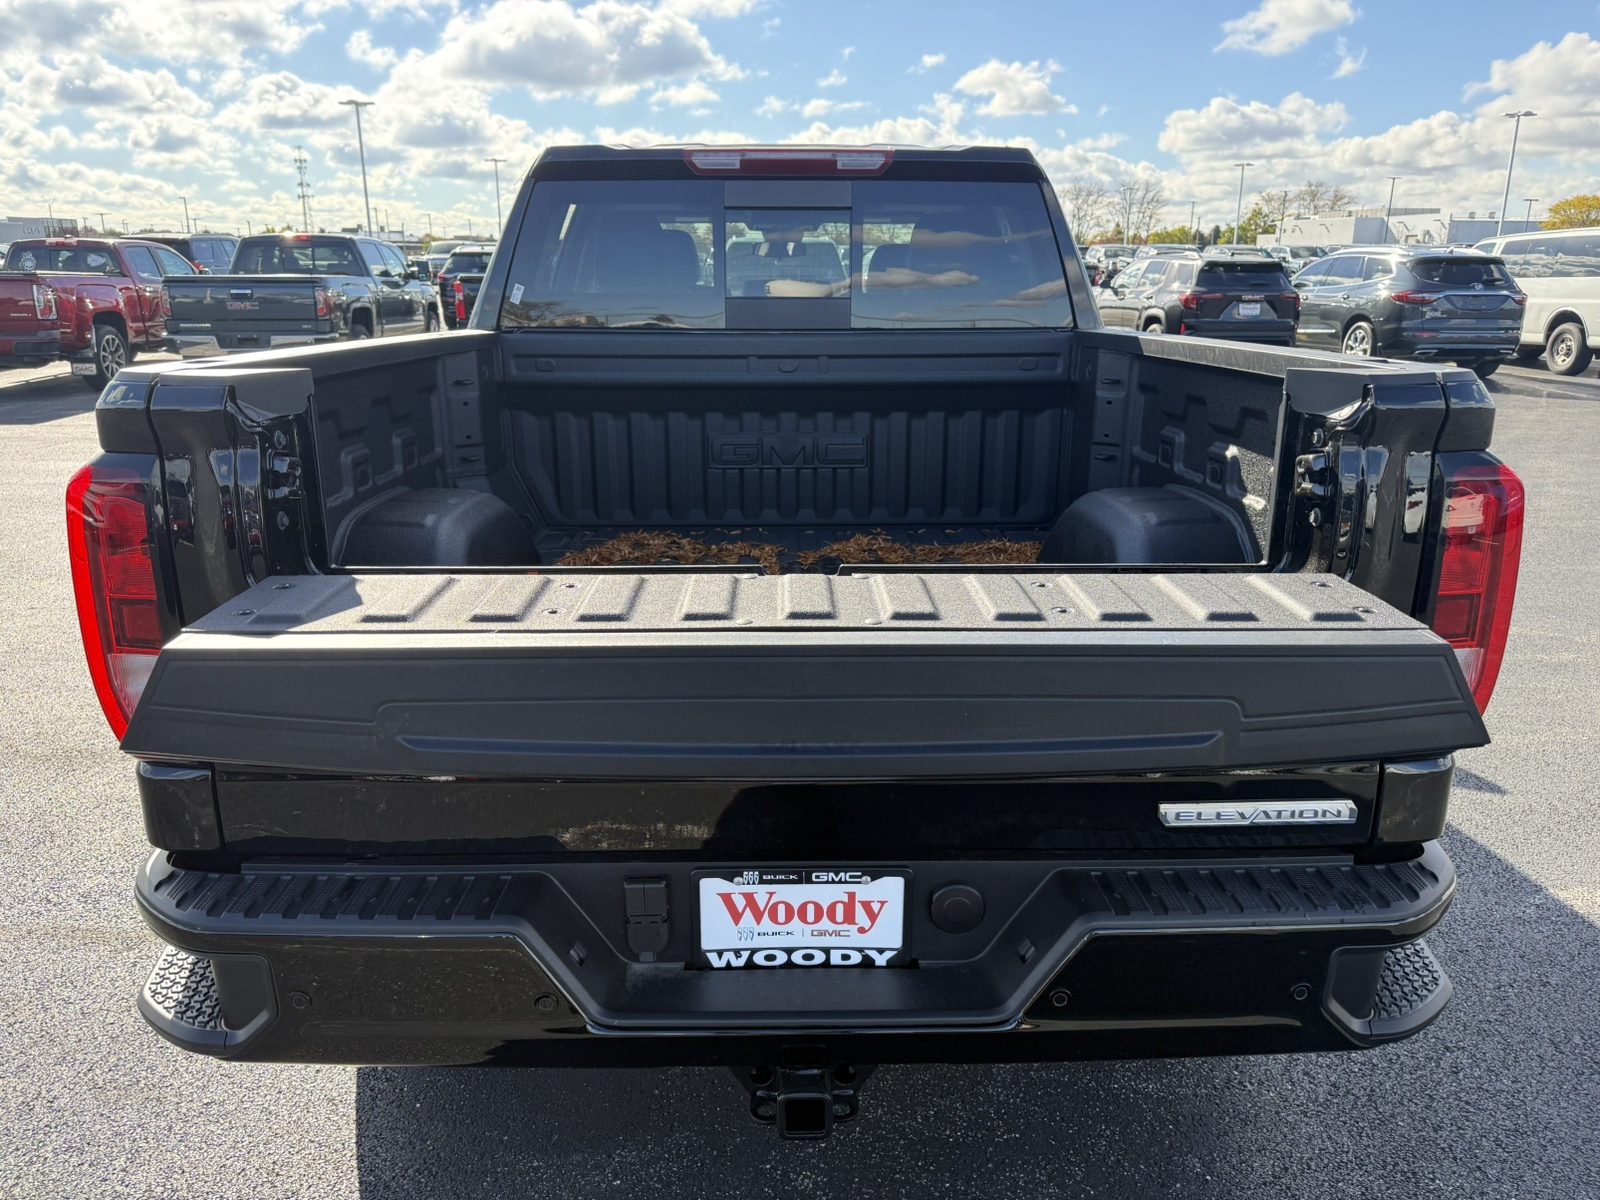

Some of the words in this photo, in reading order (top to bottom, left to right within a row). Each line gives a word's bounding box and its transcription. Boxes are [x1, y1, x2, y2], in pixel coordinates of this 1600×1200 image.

[226, 302, 259, 310] GMC
[711, 437, 865, 466] GMC
[1174, 806, 1343, 821] ELEVATION
[811, 872, 863, 882] GMC
[716, 891, 889, 935] Woody
[810, 929, 851, 938] GMC
[705, 949, 899, 968] WOODY
